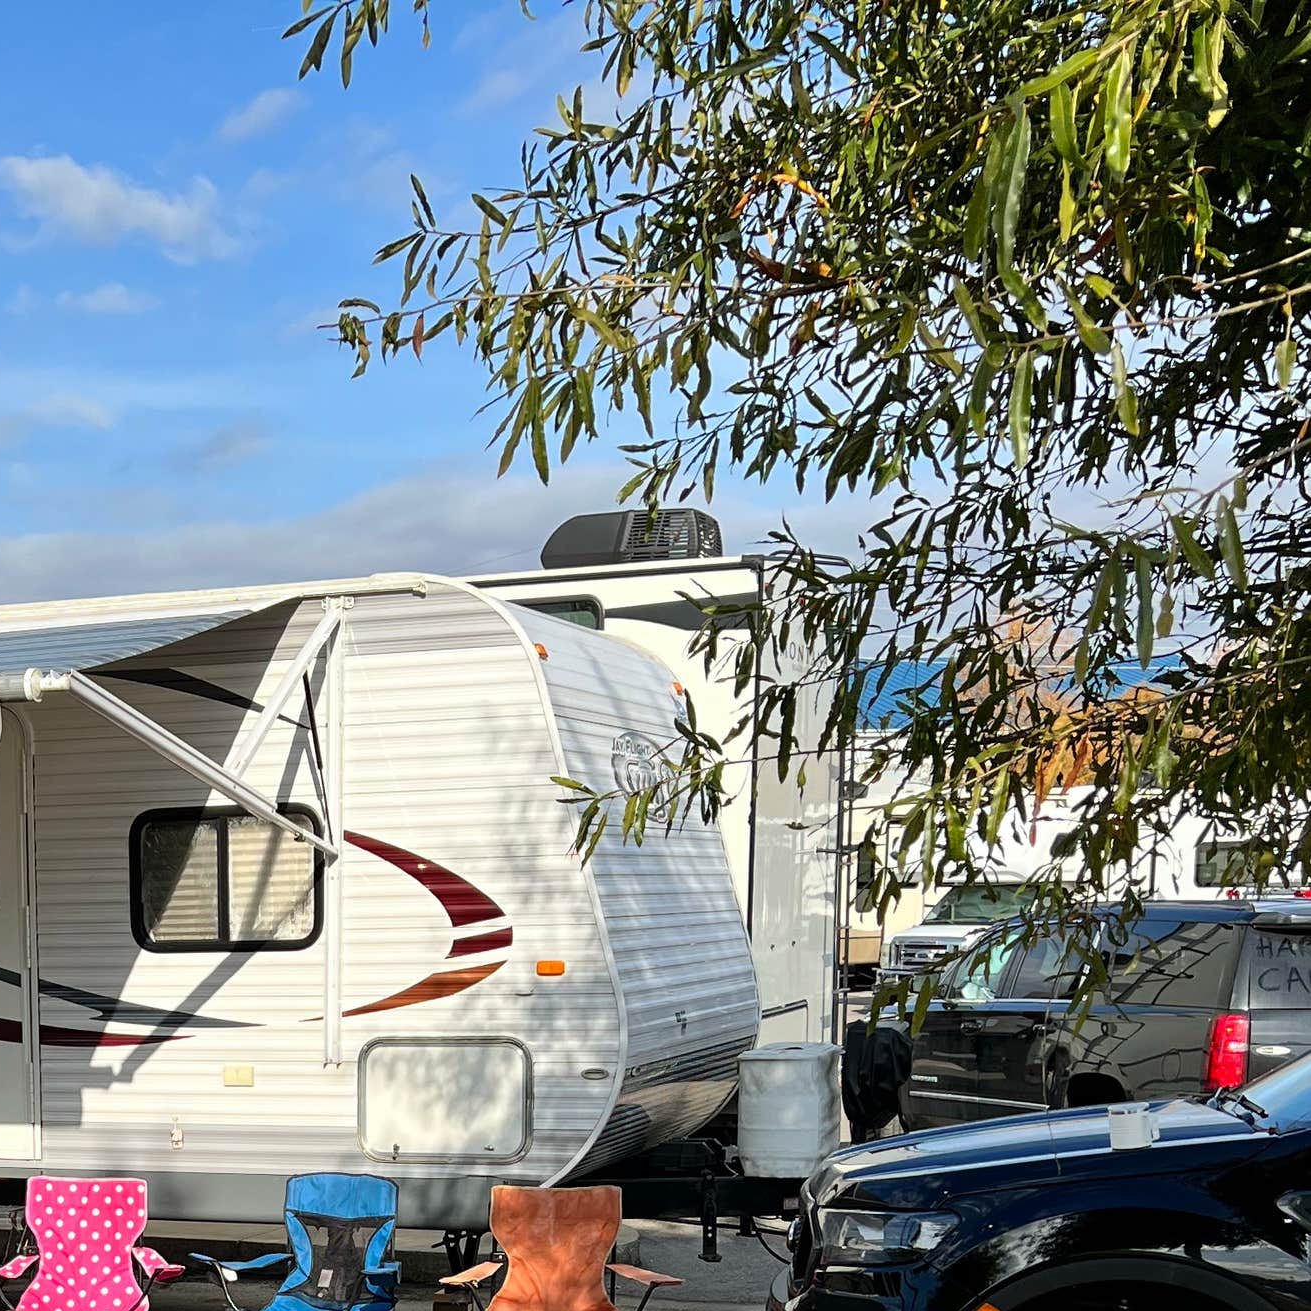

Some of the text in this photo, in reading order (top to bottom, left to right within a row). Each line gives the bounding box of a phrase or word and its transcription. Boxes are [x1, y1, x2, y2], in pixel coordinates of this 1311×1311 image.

[611, 737, 650, 755] JAY FLIGHT
[1257, 966, 1311, 993] CA
